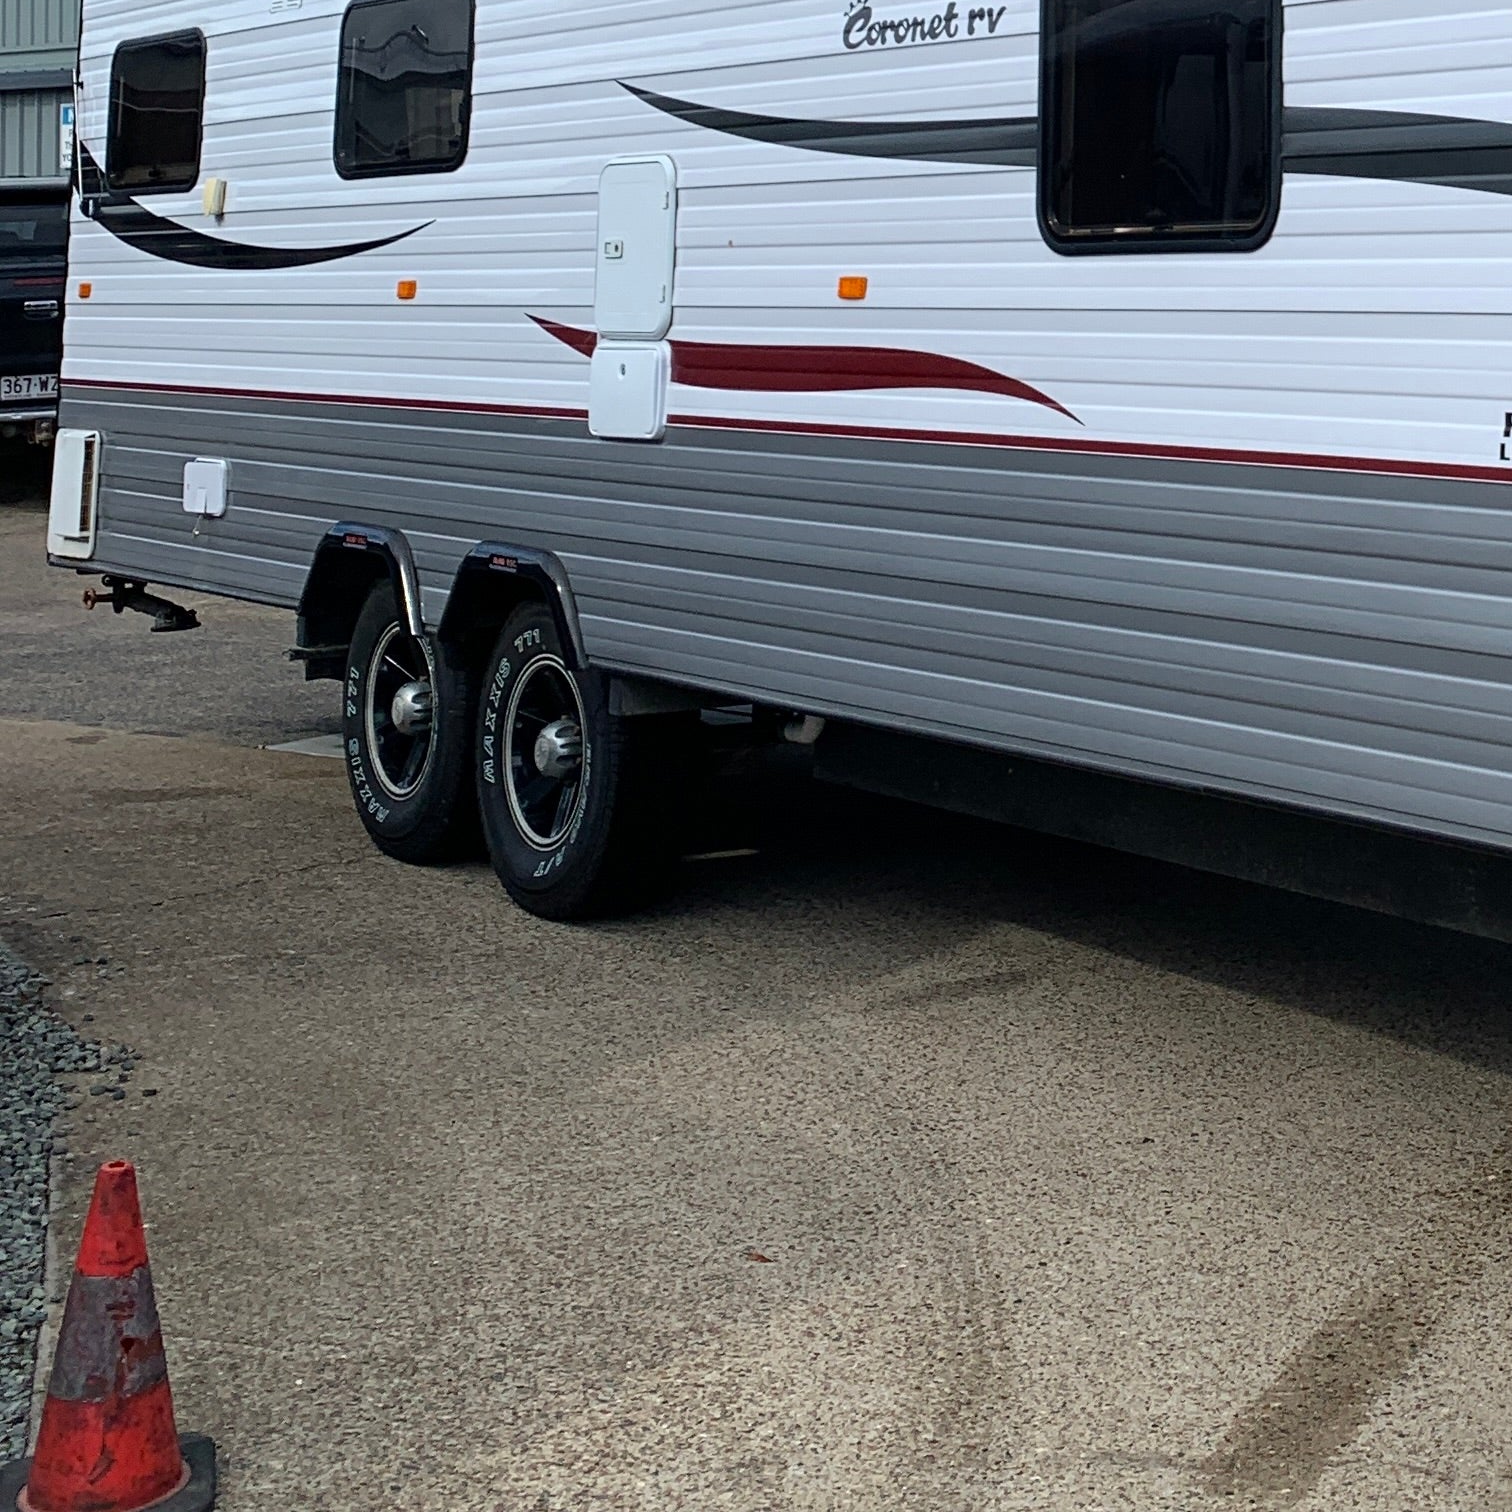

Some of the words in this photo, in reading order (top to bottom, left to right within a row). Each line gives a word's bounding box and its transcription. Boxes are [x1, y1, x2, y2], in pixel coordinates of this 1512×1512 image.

[843, 1, 959, 50] Coronet
[966, 5, 1007, 37] rv
[484, 657, 511, 784] MAXXIS
[514, 628, 541, 653] 771
